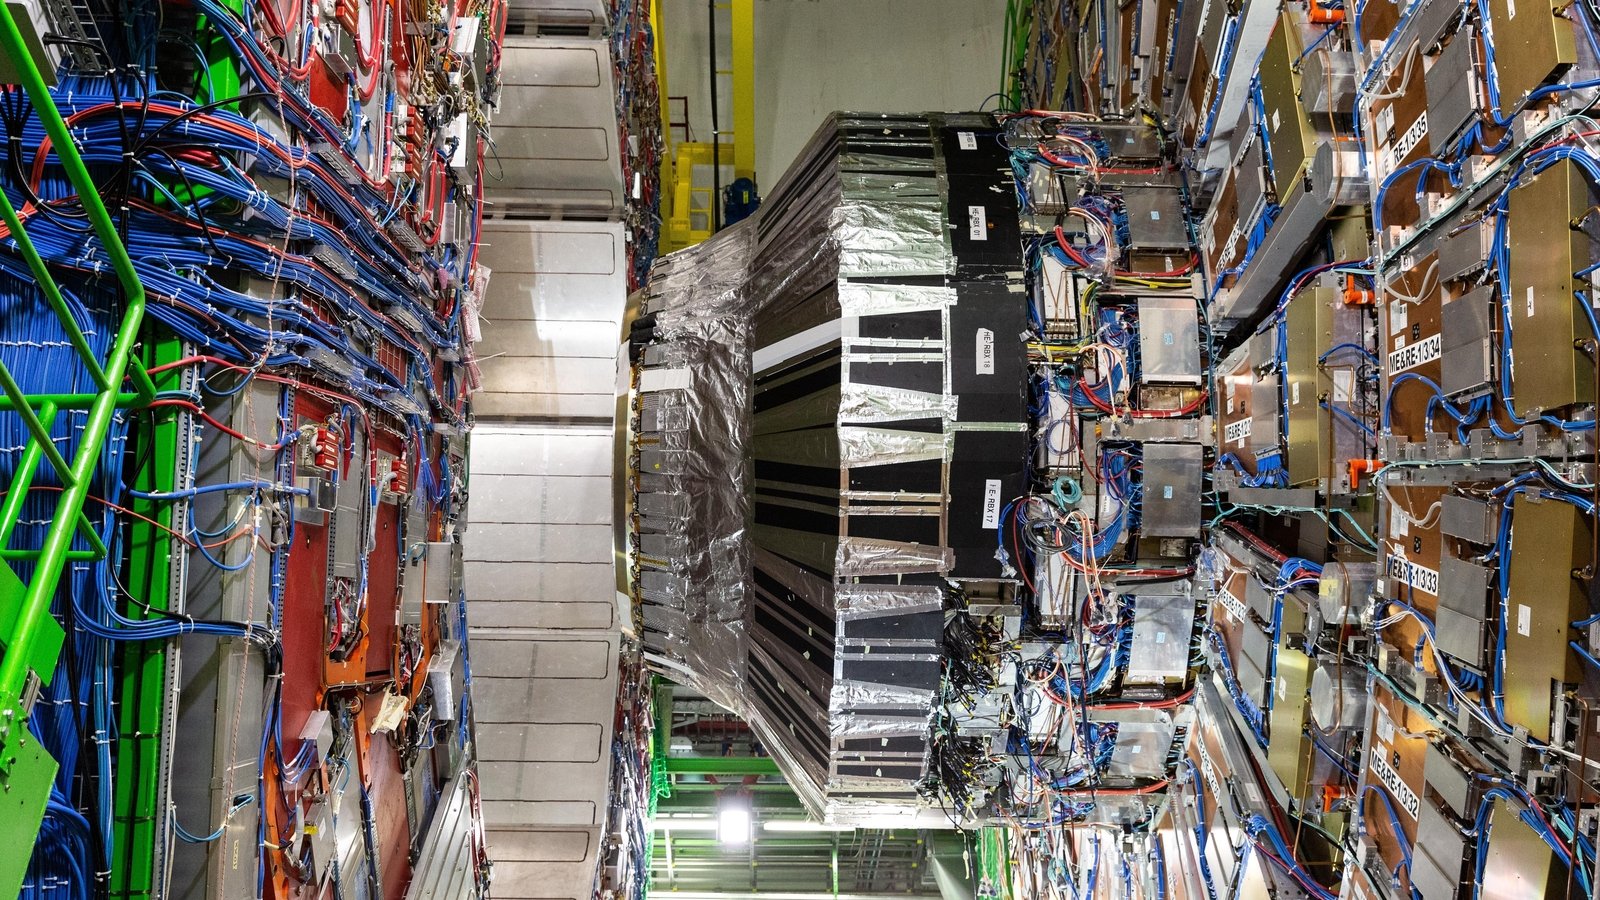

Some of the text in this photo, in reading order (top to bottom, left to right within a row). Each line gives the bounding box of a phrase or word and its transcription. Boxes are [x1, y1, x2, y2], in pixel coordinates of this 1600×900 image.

[983, 361, 991, 369] 18
[1390, 337, 1440, 373] ME&RE-1/3/34
[986, 515, 993, 523] 17
[1372, 750, 1418, 817] ME&RE-1/3/32
